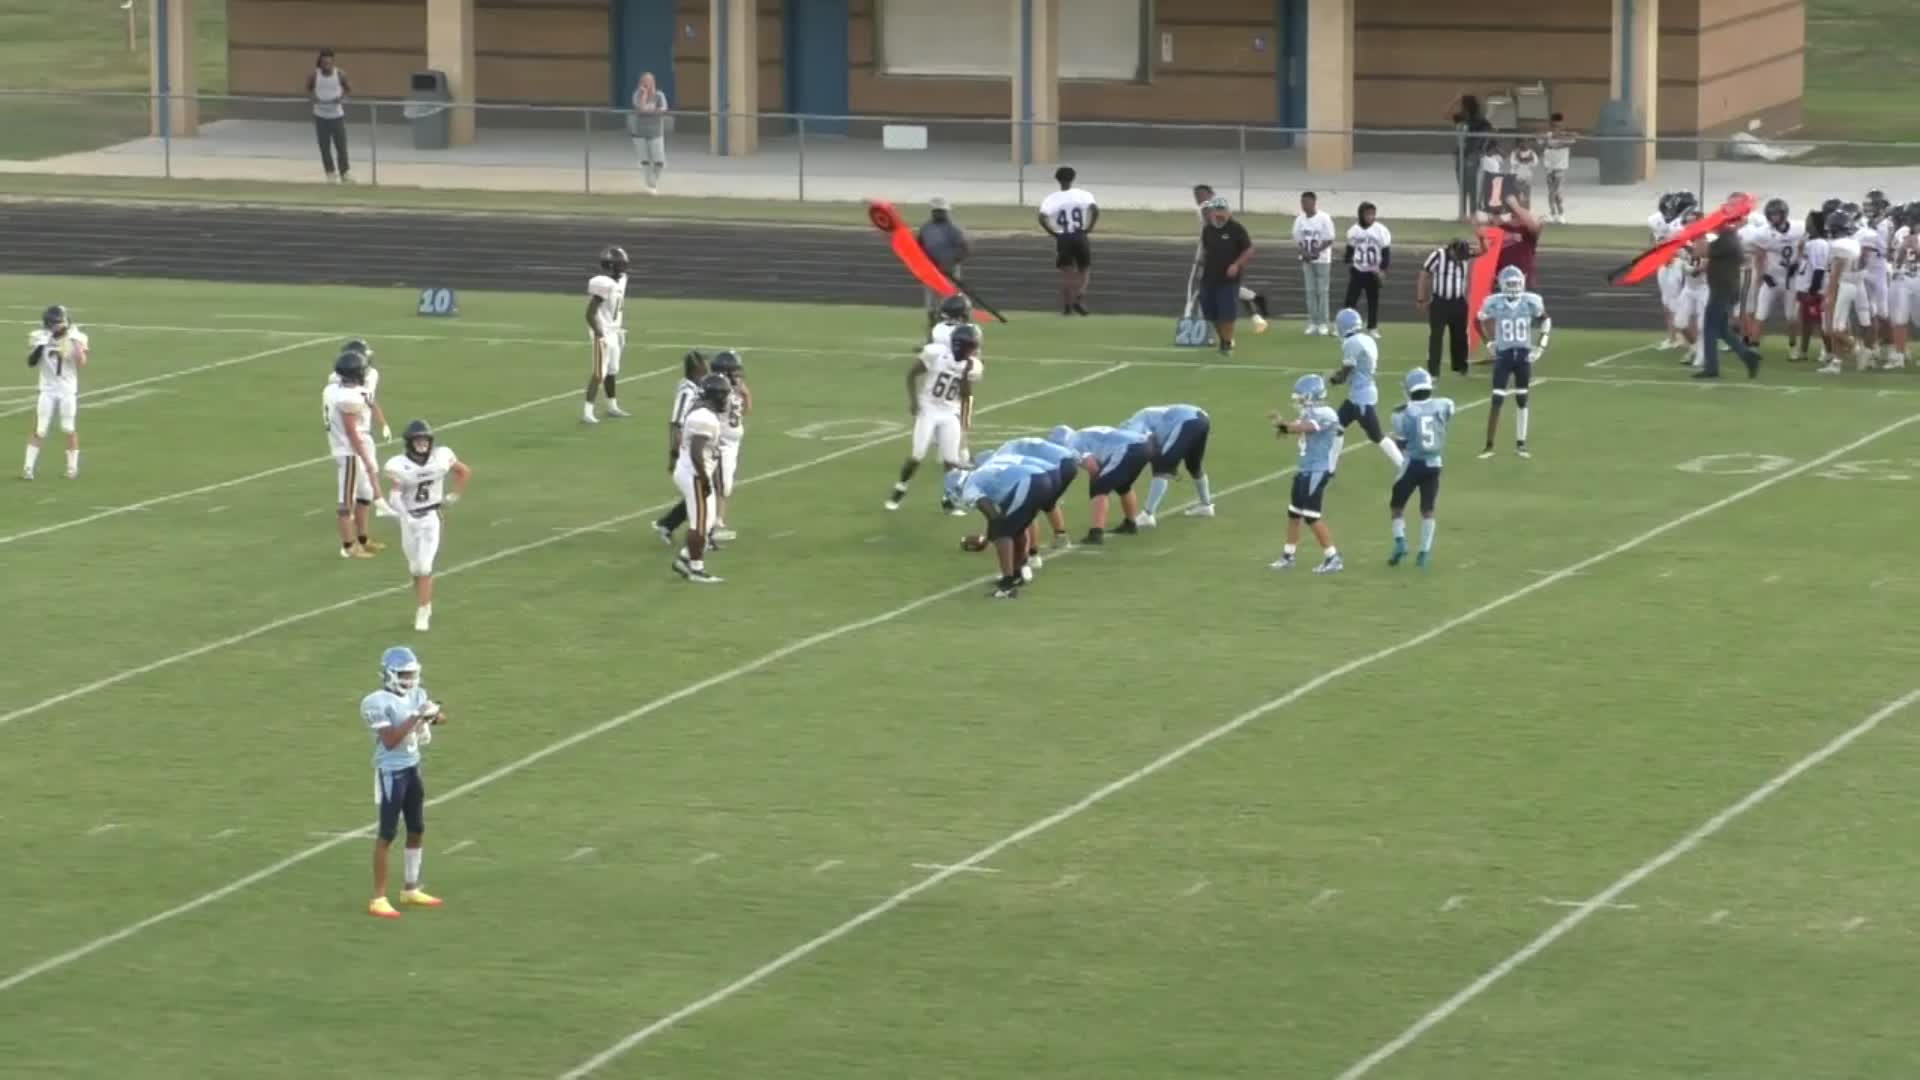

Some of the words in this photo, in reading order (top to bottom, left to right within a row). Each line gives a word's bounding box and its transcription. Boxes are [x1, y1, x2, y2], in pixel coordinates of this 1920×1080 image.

[1488, 176, 1504, 207] 1
[1056, 207, 1083, 233] 49
[419, 288, 450, 313] 10
[1176, 319, 1206, 345] 20
[1502, 317, 1527, 342] 80
[1420, 415, 1435, 450] 5
